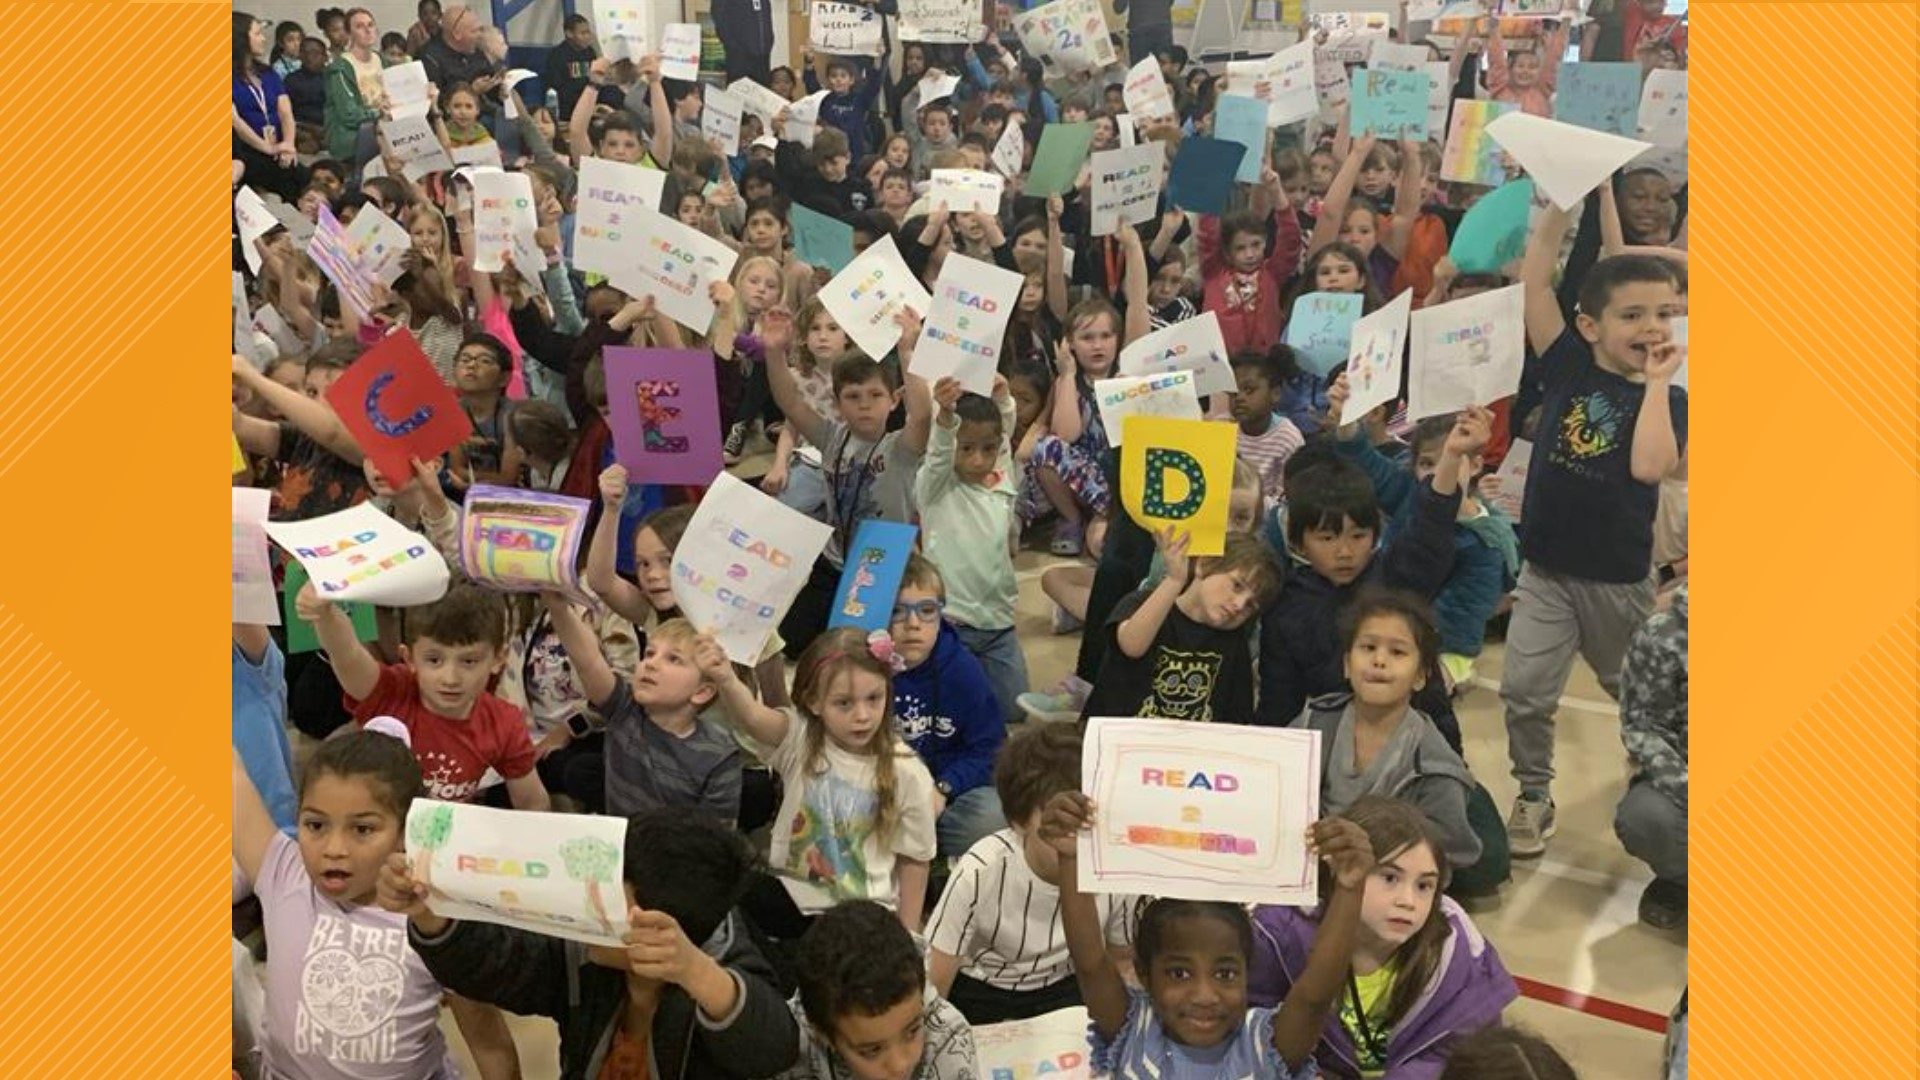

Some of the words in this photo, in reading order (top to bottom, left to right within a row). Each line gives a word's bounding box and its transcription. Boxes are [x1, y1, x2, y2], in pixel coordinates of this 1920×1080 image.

[861, 10, 873, 22] 2
[1103, 165, 1151, 184] READ
[608, 213, 620, 225] 2
[945, 286, 998, 314] READ
[957, 316, 971, 330] 2
[926, 327, 995, 358] SUCCEED
[364, 371, 434, 437] C
[1104, 374, 1188, 407] SUCCEED
[634, 380, 689, 453] E
[1143, 447, 1207, 520] D
[295, 530, 378, 559] READ
[726, 562, 748, 583] 2
[675, 561, 776, 619] SUCCEED
[1141, 767, 1240, 793] READ
[1180, 804, 1203, 823] 2
[457, 854, 550, 879] READ
[307, 913, 346, 957] BE
[296, 1006, 325, 1055] BE
[327, 1016, 398, 1064] KIND
